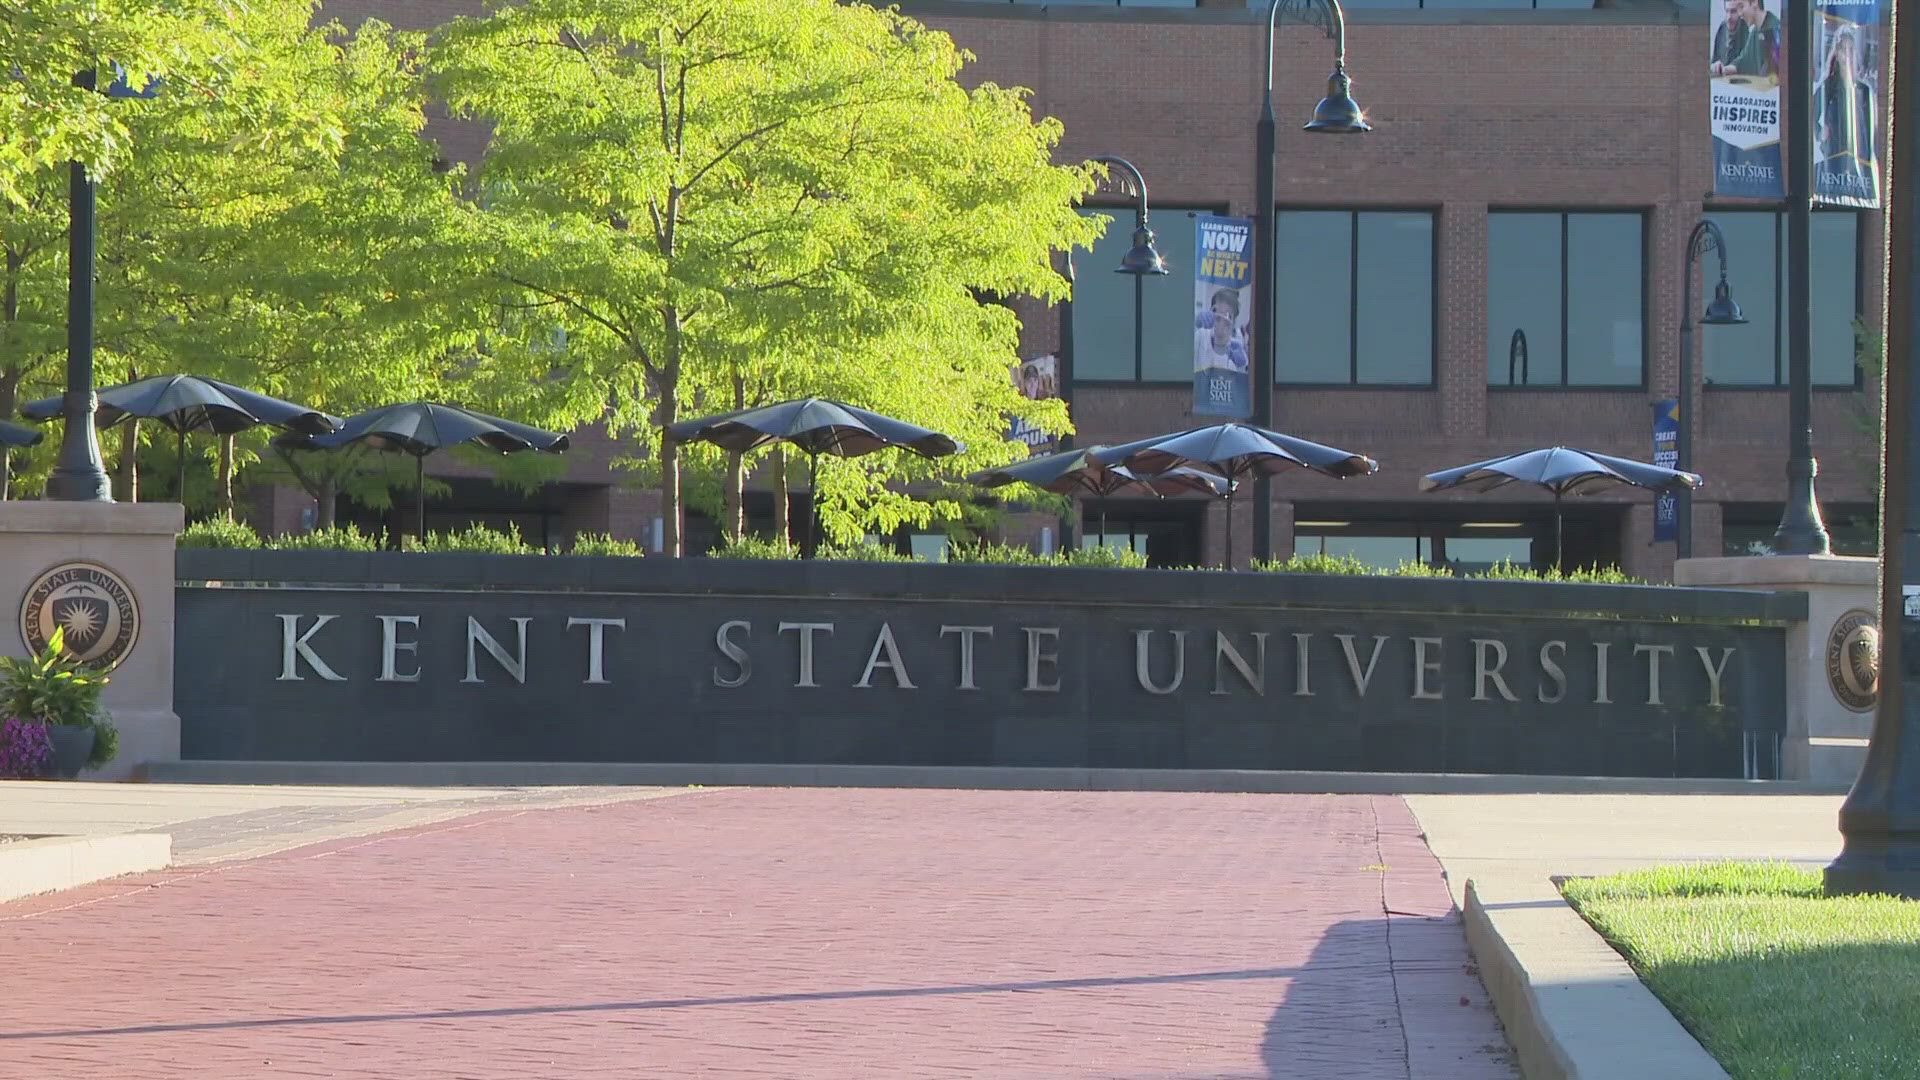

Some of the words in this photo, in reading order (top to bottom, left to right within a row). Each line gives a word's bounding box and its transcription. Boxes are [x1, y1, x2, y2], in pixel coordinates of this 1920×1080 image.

[1713, 95, 1777, 108] COLLABORATION
[1713, 106, 1777, 125] INSPIRES
[1722, 123, 1769, 135] INNOVATION
[1721, 163, 1746, 177] KENT
[1748, 165, 1775, 179] STATE
[1821, 171, 1845, 186] KENT
[1201, 222, 1222, 231] LEARN
[1223, 224, 1249, 234] WHAT'S
[1202, 230, 1248, 253] NOW
[1200, 257, 1249, 281] NEXT
[1210, 379, 1233, 391] KENT
[1210, 390, 1233, 402] STATE
[27, 597, 42, 641] KENT
[38, 569, 80, 598] STATE
[89, 569, 134, 647] UNIVERSITY
[273, 613, 627, 685] KENT
[712, 619, 1062, 694] STATE
[1134, 628, 1736, 709] UNIVERSITY
